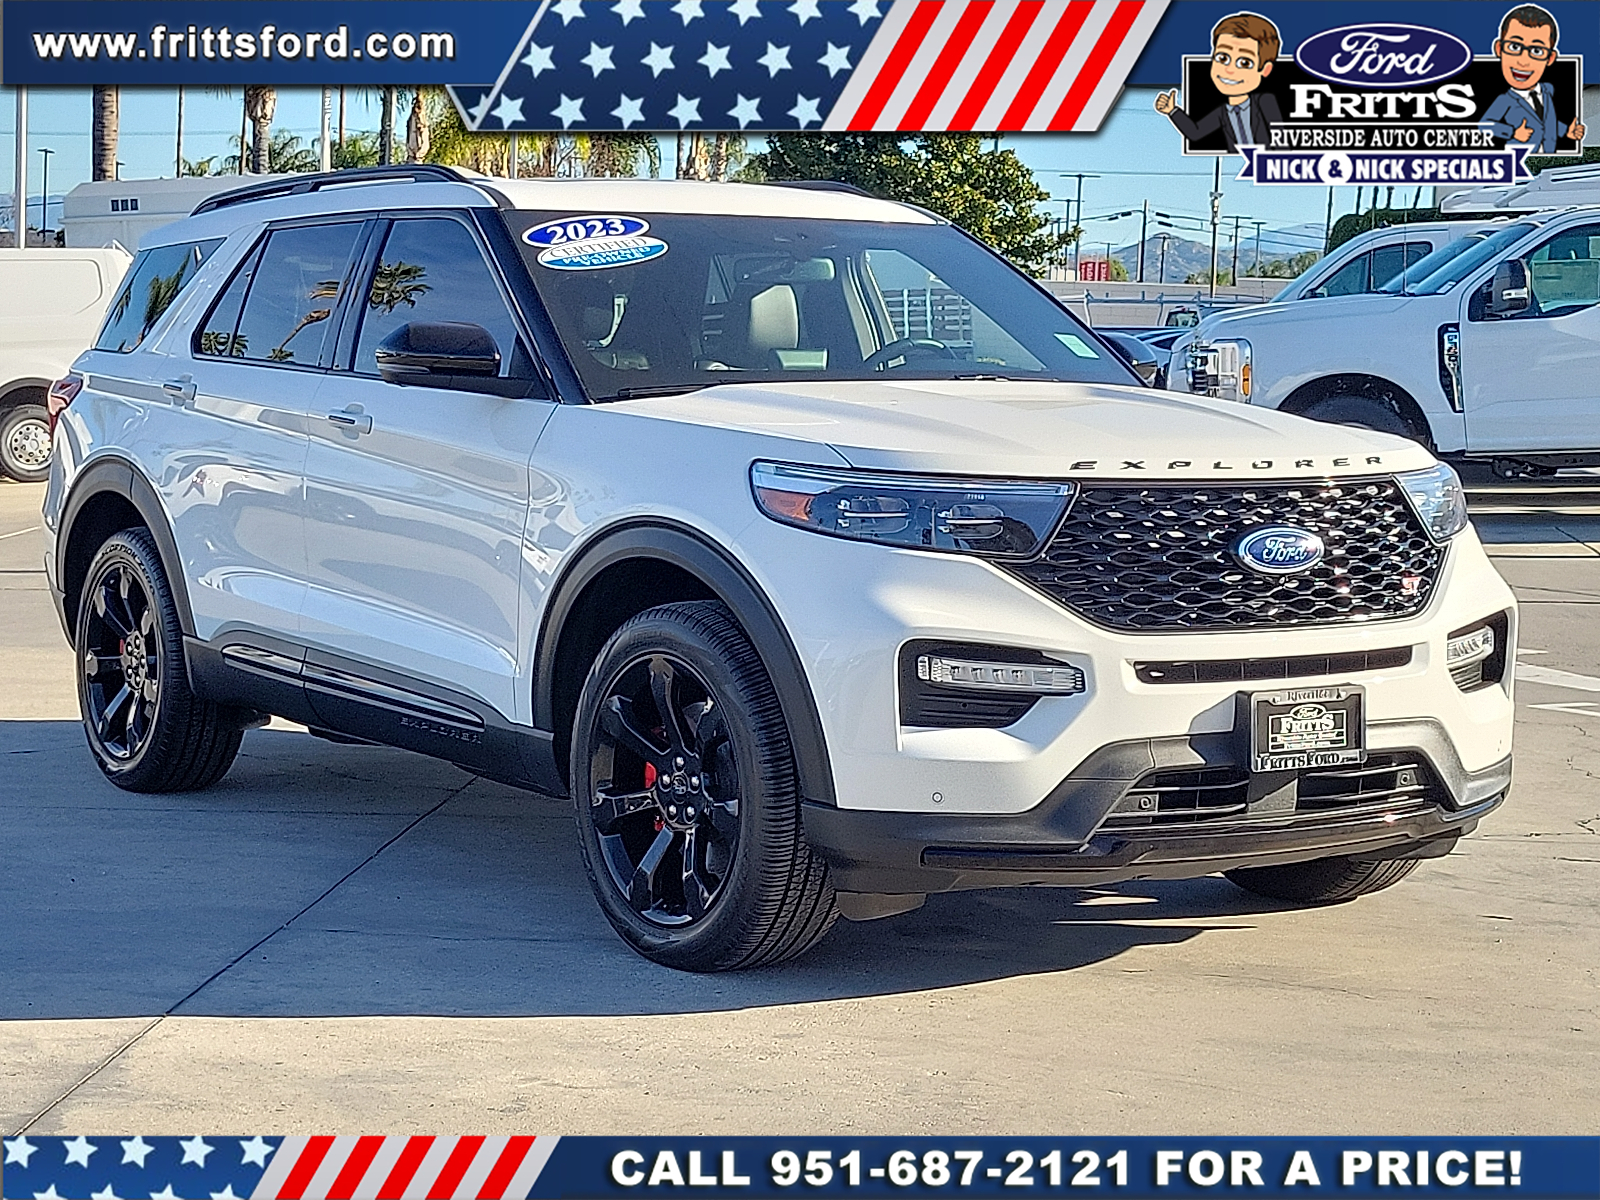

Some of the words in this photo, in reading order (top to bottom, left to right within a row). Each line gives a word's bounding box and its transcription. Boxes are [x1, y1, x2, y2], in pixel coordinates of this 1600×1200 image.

[546, 218, 626, 245] 2023
[549, 237, 648, 258] CERTIFIED
[1069, 455, 1383, 471] EXPLORER
[1262, 536, 1309, 563] Ford
